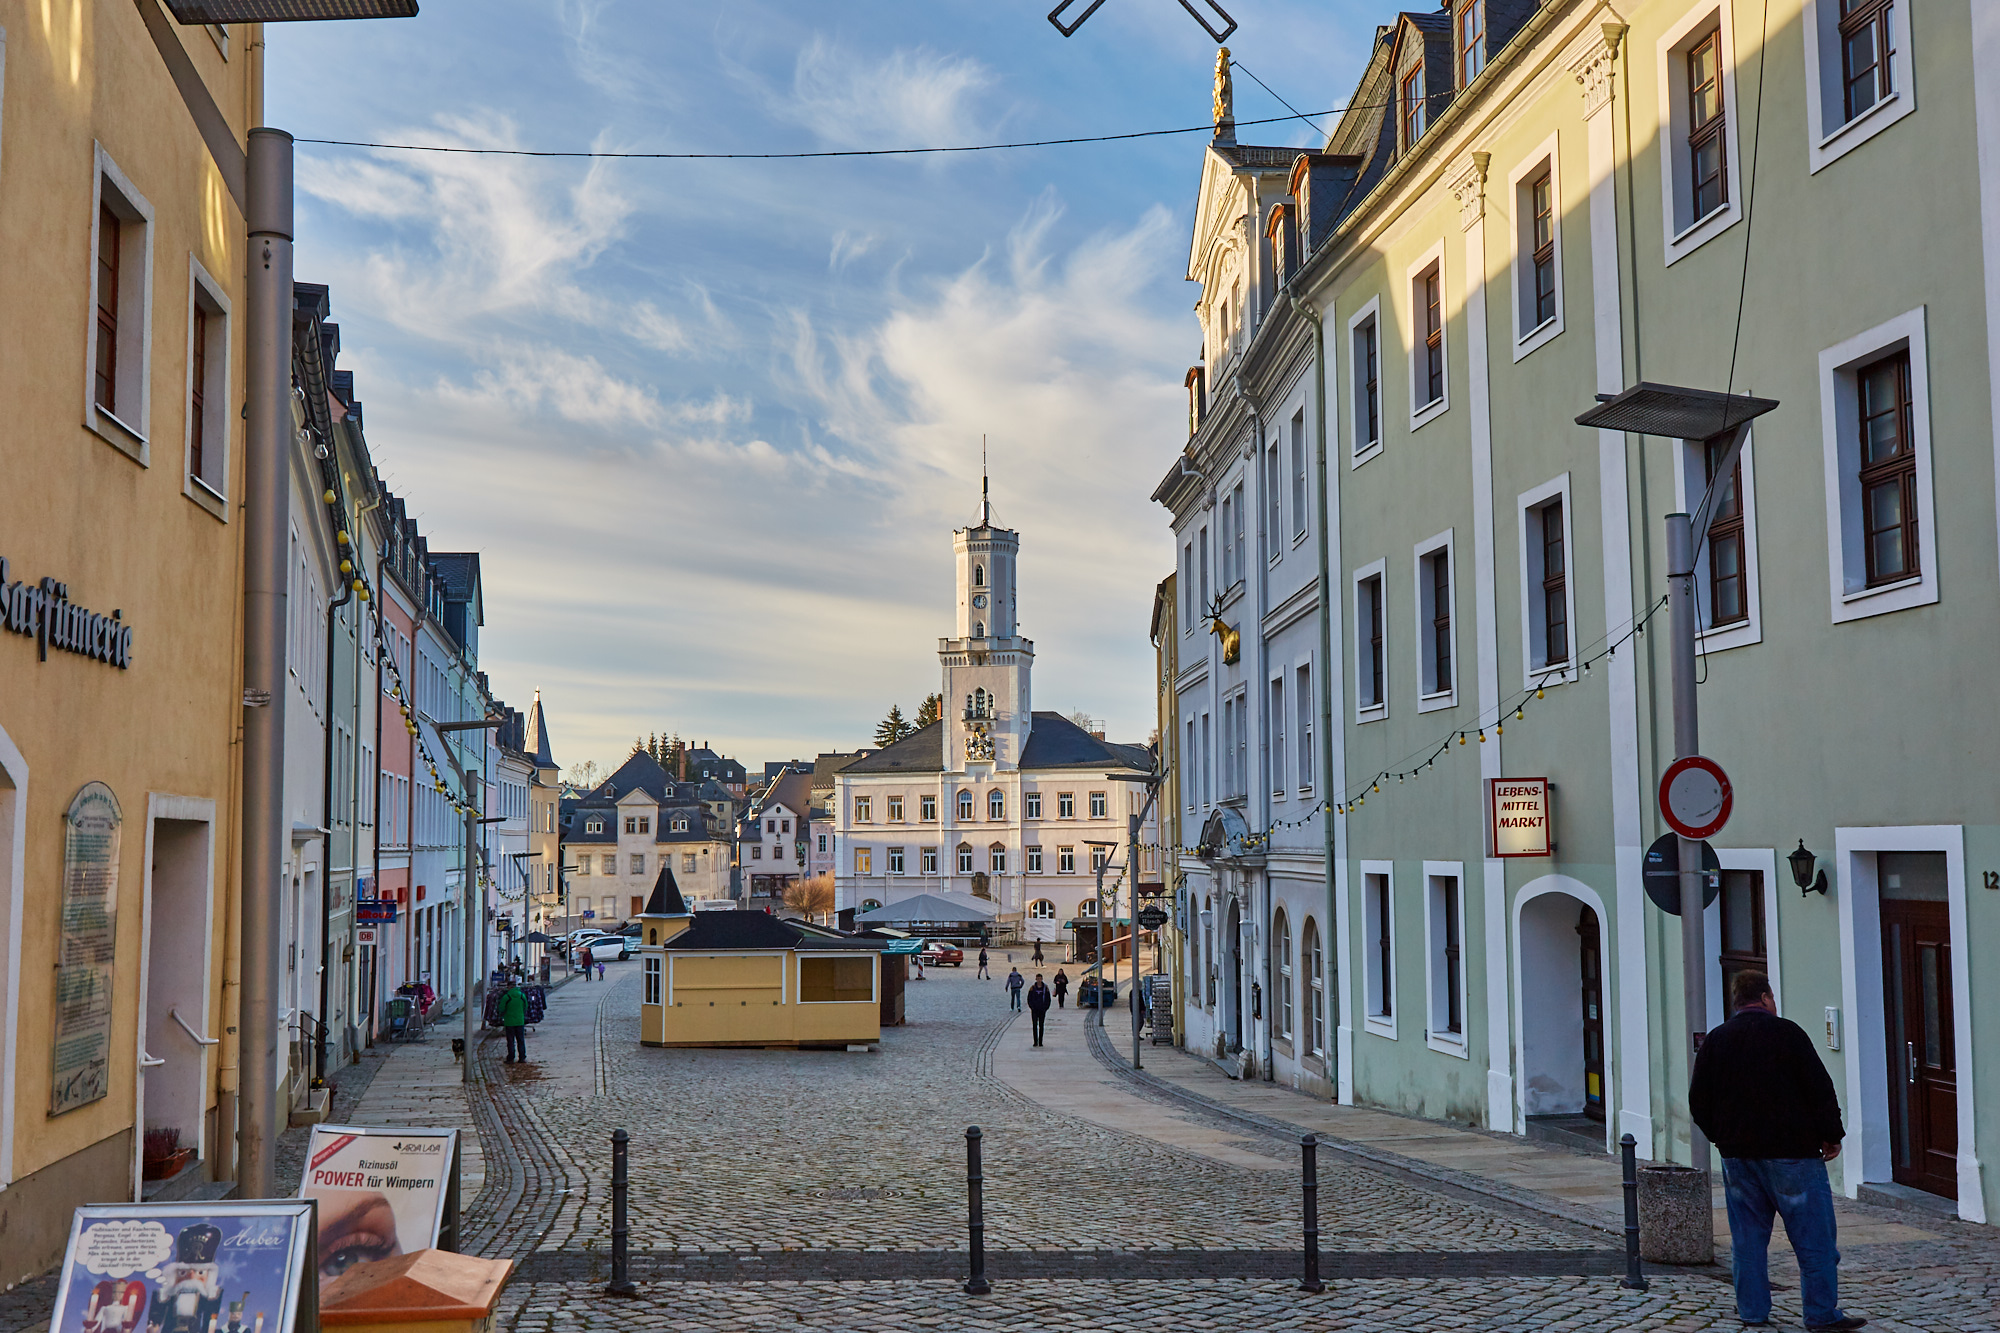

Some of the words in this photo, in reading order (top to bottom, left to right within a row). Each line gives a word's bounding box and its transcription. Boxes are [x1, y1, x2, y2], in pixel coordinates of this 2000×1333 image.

[1497, 786, 1542, 797] LEBENS-
[1501, 801, 1539, 811] MITTEL
[1498, 816, 1544, 828] MARKT
[1983, 870, 1999, 890] 12
[361, 932, 372, 940] DB
[358, 1160, 398, 1170] Rizinusöl
[314, 1170, 364, 1187] POWER
[366, 1175, 383, 1188] für
[386, 1176, 434, 1190] Wimpern
[223, 1225, 284, 1247] Huber
